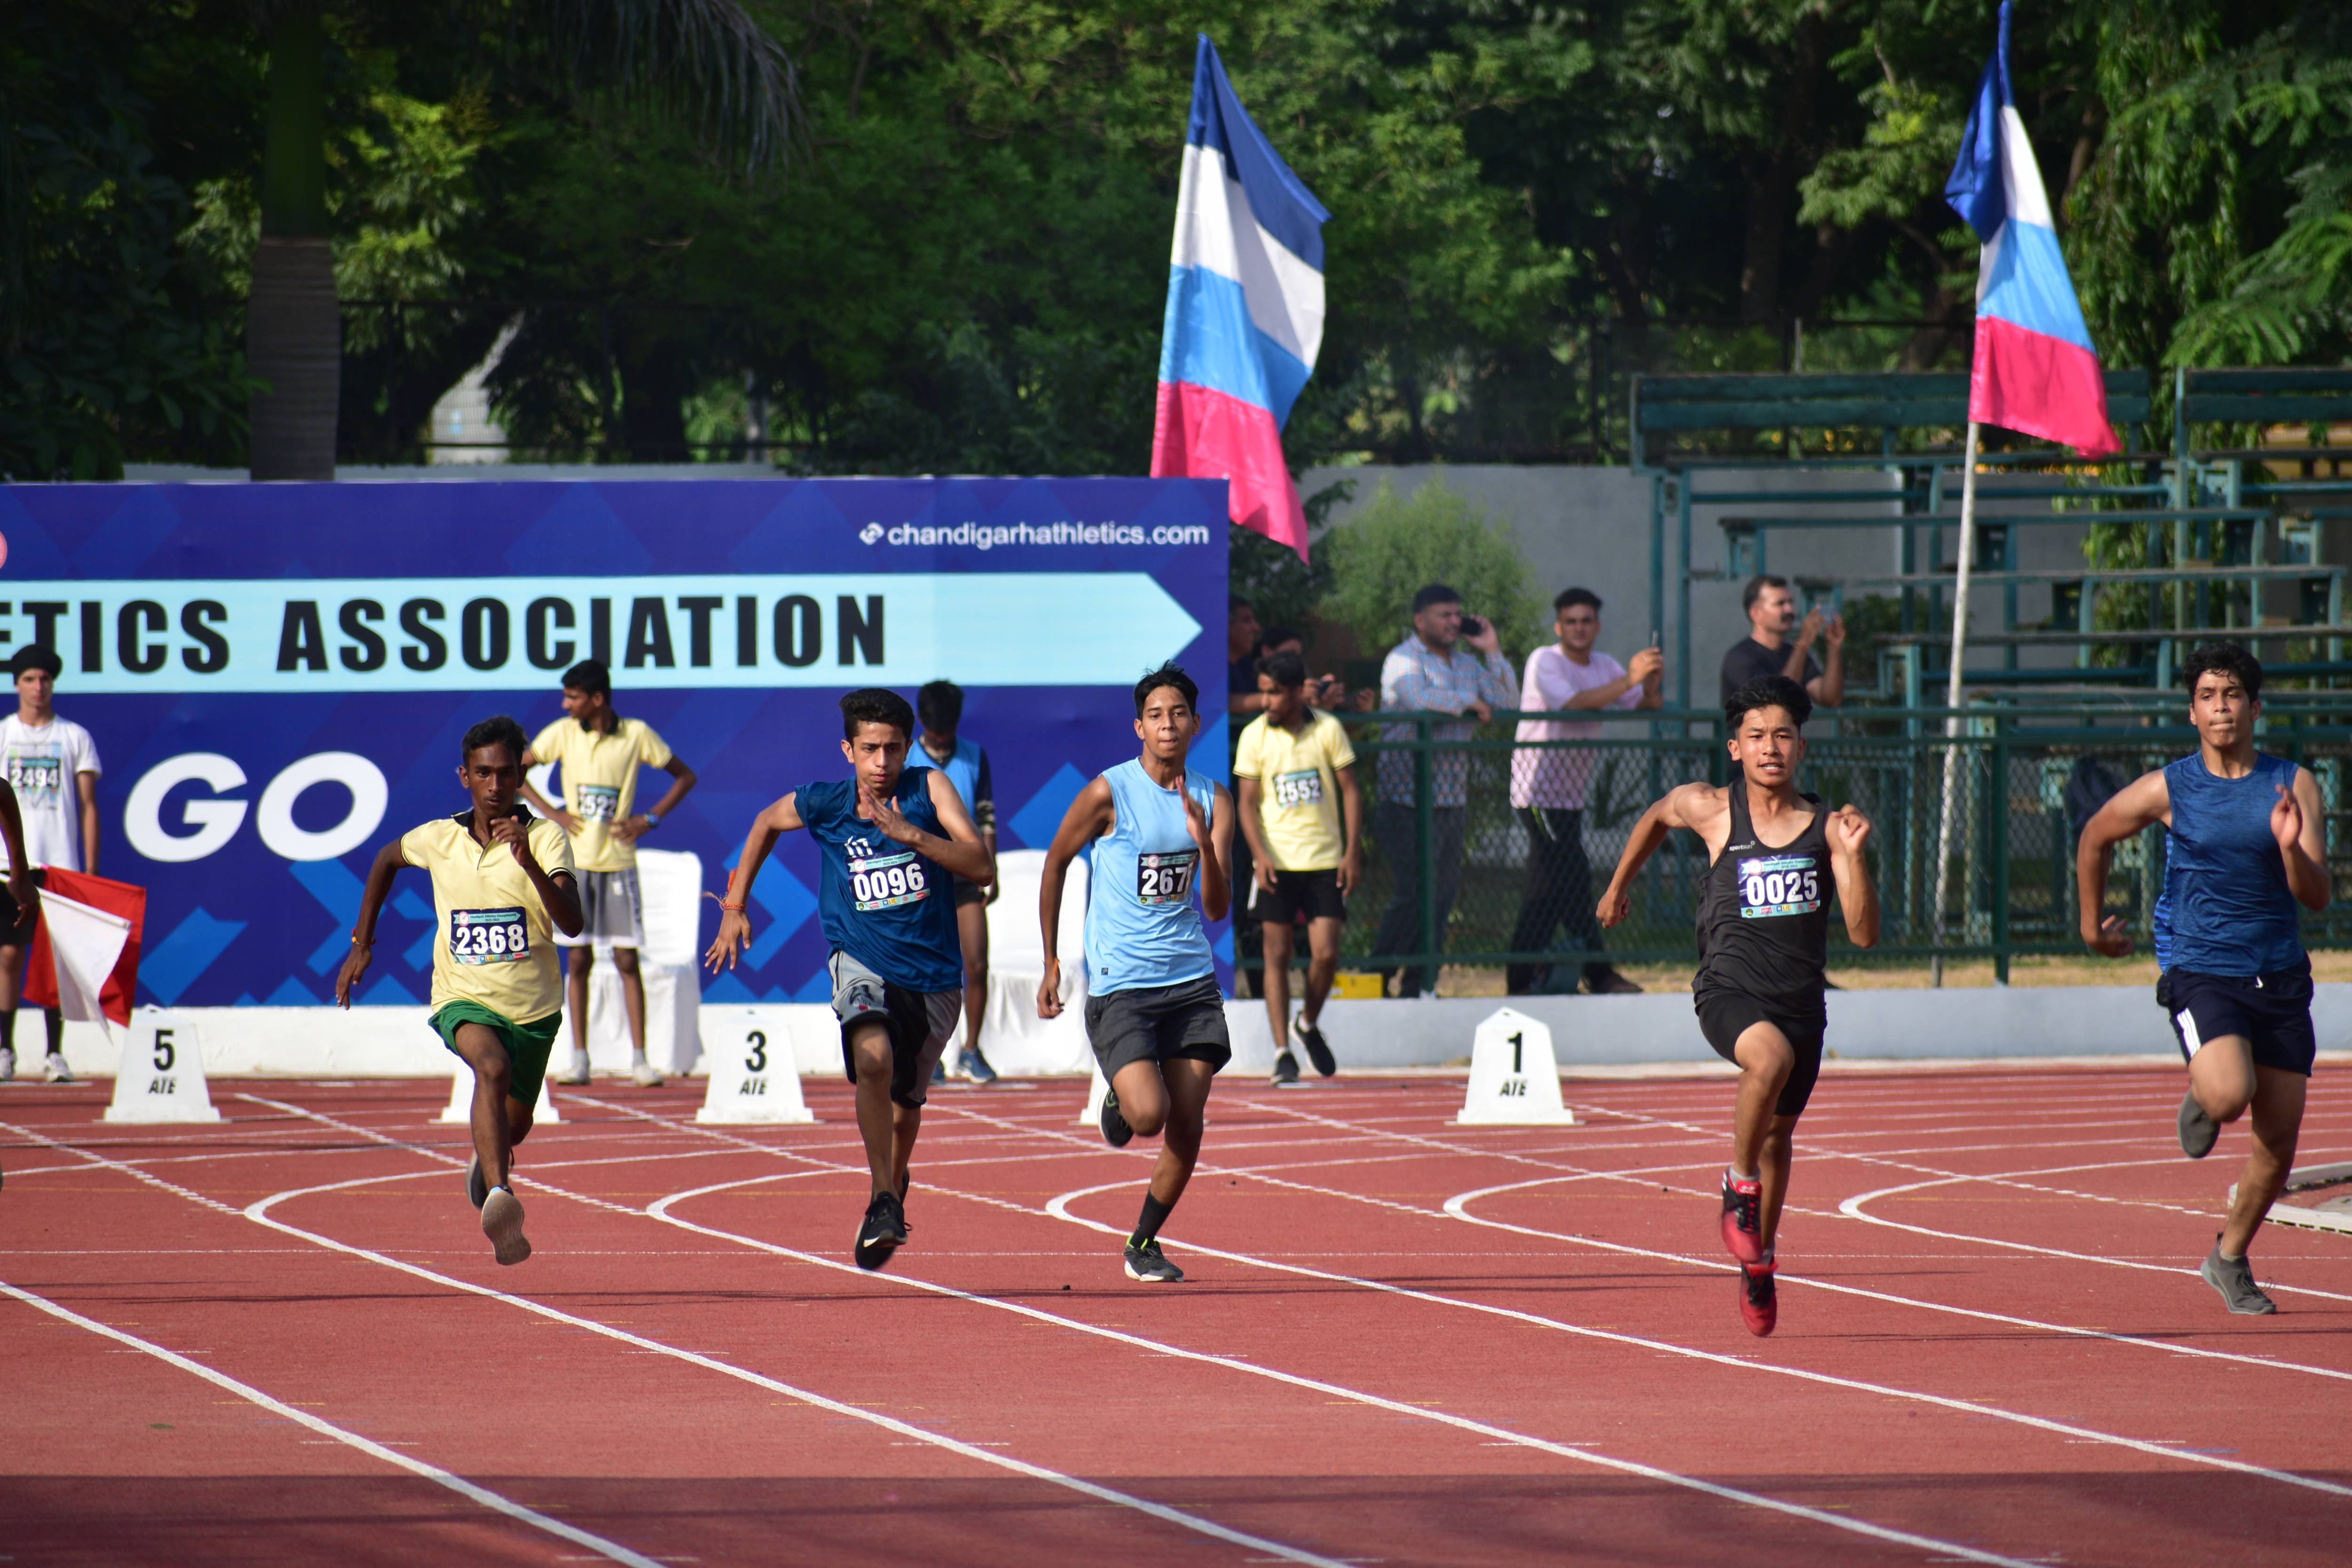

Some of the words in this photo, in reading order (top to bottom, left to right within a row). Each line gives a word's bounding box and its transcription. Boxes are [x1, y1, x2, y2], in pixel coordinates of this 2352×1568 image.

[887, 521, 1209, 550] chandigarhathletics.com
[0, 599, 229, 674] TICS
[276, 594, 884, 676] ASSOCIATION
[11, 767, 58, 787] 2494
[125, 752, 388, 862] GO
[854, 863, 924, 901] 0096
[1747, 871, 1817, 906] 0025
[455, 924, 525, 954] 2368
[154, 1029, 175, 1071] 5
[745, 1031, 766, 1072] 3
[1508, 1032, 1522, 1073] 1
[149, 1077, 176, 1094] ATE
[739, 1078, 768, 1095] ATE
[1500, 1081, 1527, 1097] ATE
